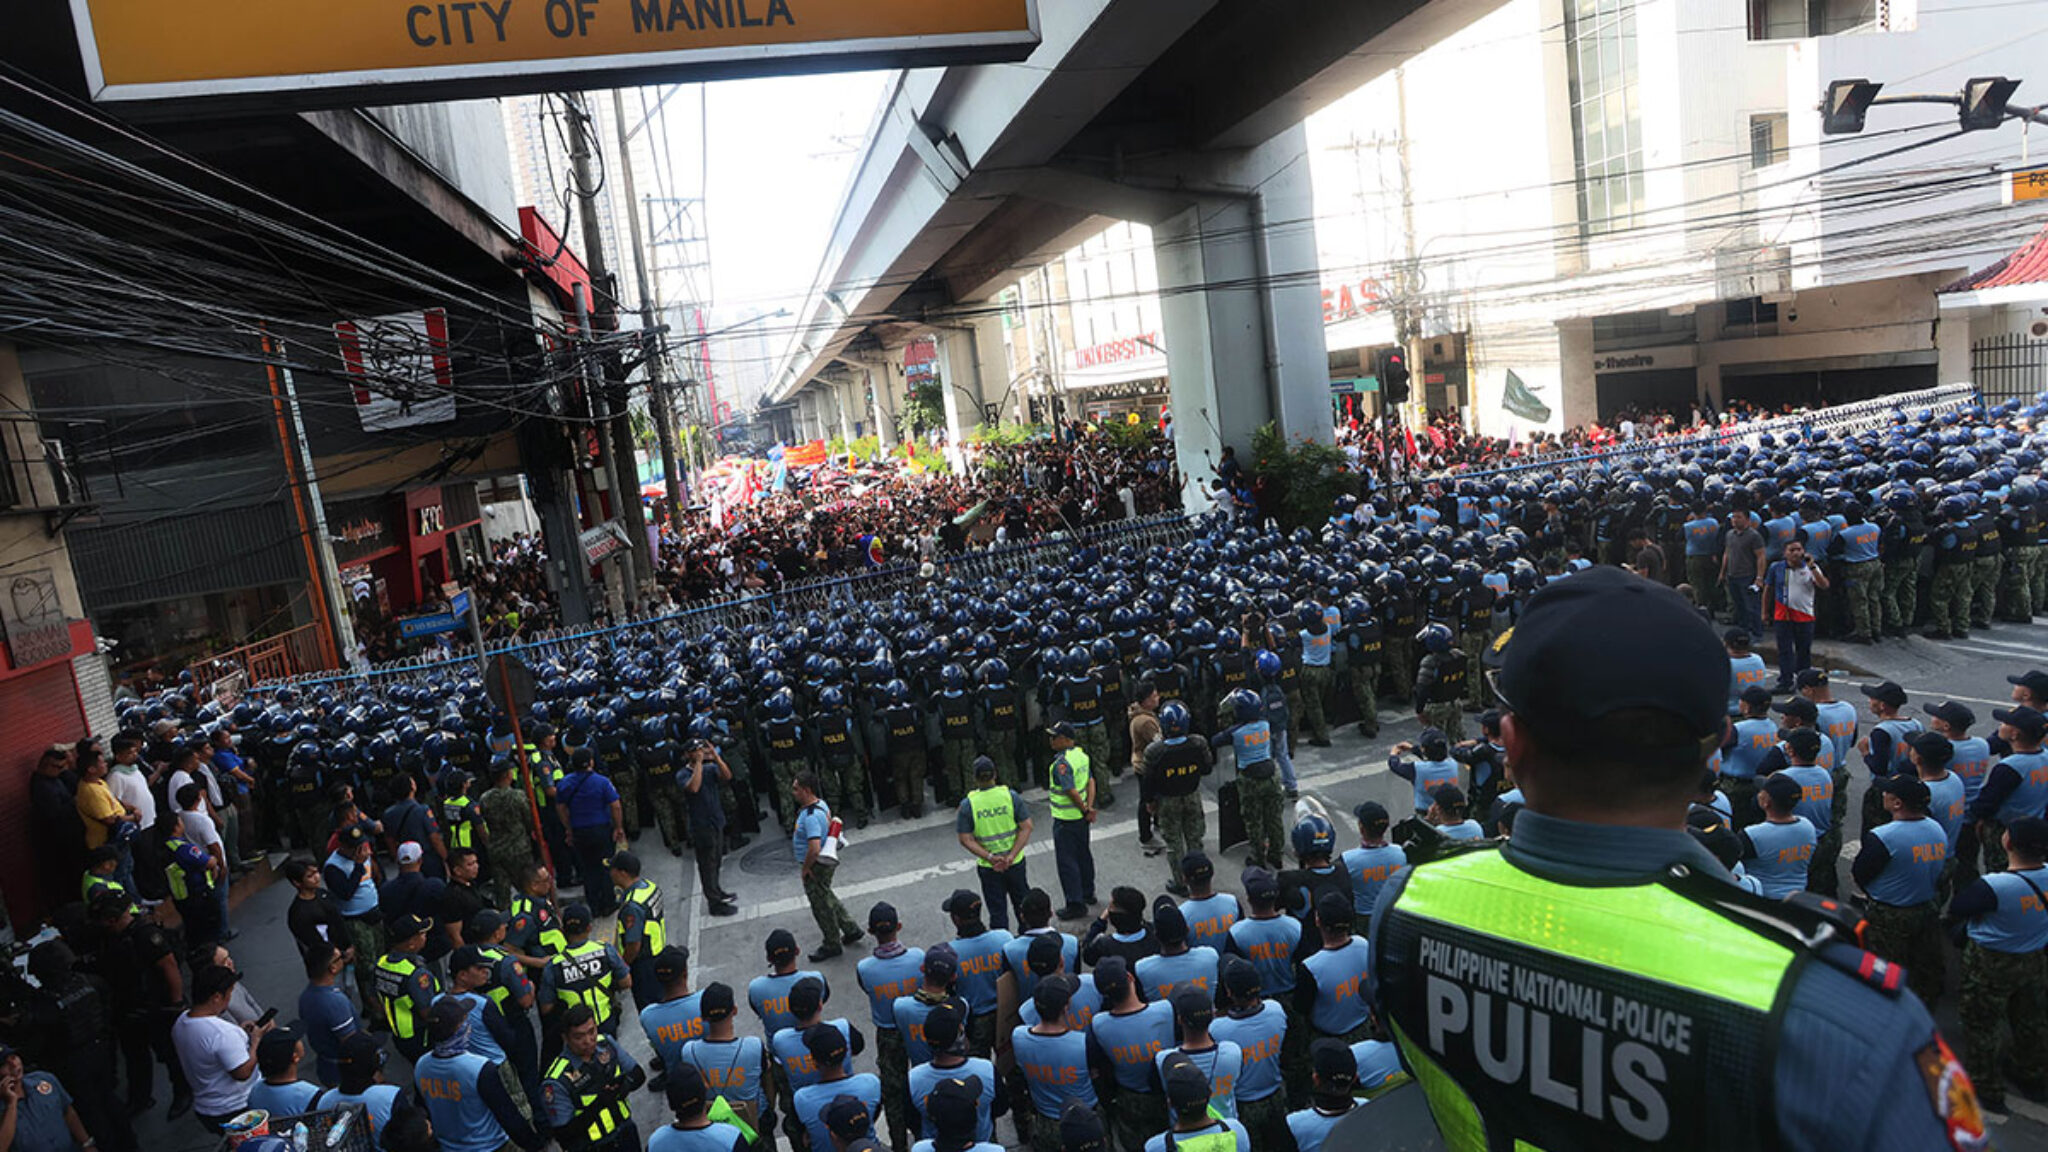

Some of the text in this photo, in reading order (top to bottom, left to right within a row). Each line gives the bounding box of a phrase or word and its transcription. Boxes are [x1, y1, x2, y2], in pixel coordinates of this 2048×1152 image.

[407, 0, 796, 47] CITY OF MANILA
[1321, 275, 1380, 321] EAS
[1074, 331, 1156, 369] UNIVERSITY
[420, 504, 445, 537] KFC
[976, 805, 1008, 819] POLICE
[1911, 843, 1946, 864] PULIS
[1194, 914, 1235, 939] PULIS
[1250, 942, 1290, 960] PULIS
[562, 959, 602, 984] MPD
[959, 952, 1001, 978] PULIS
[874, 976, 917, 1000] PULIS
[1419, 936, 1693, 1056] PHILIPPINE NATIONAL POLICE
[656, 1016, 704, 1044] PULIS
[1112, 1040, 1161, 1065] PULIS
[1242, 1034, 1281, 1065] PULIS
[1427, 973, 1670, 1142] PULIS
[1024, 1063, 1078, 1085] PULIS
[420, 1077, 462, 1101] PULIS
